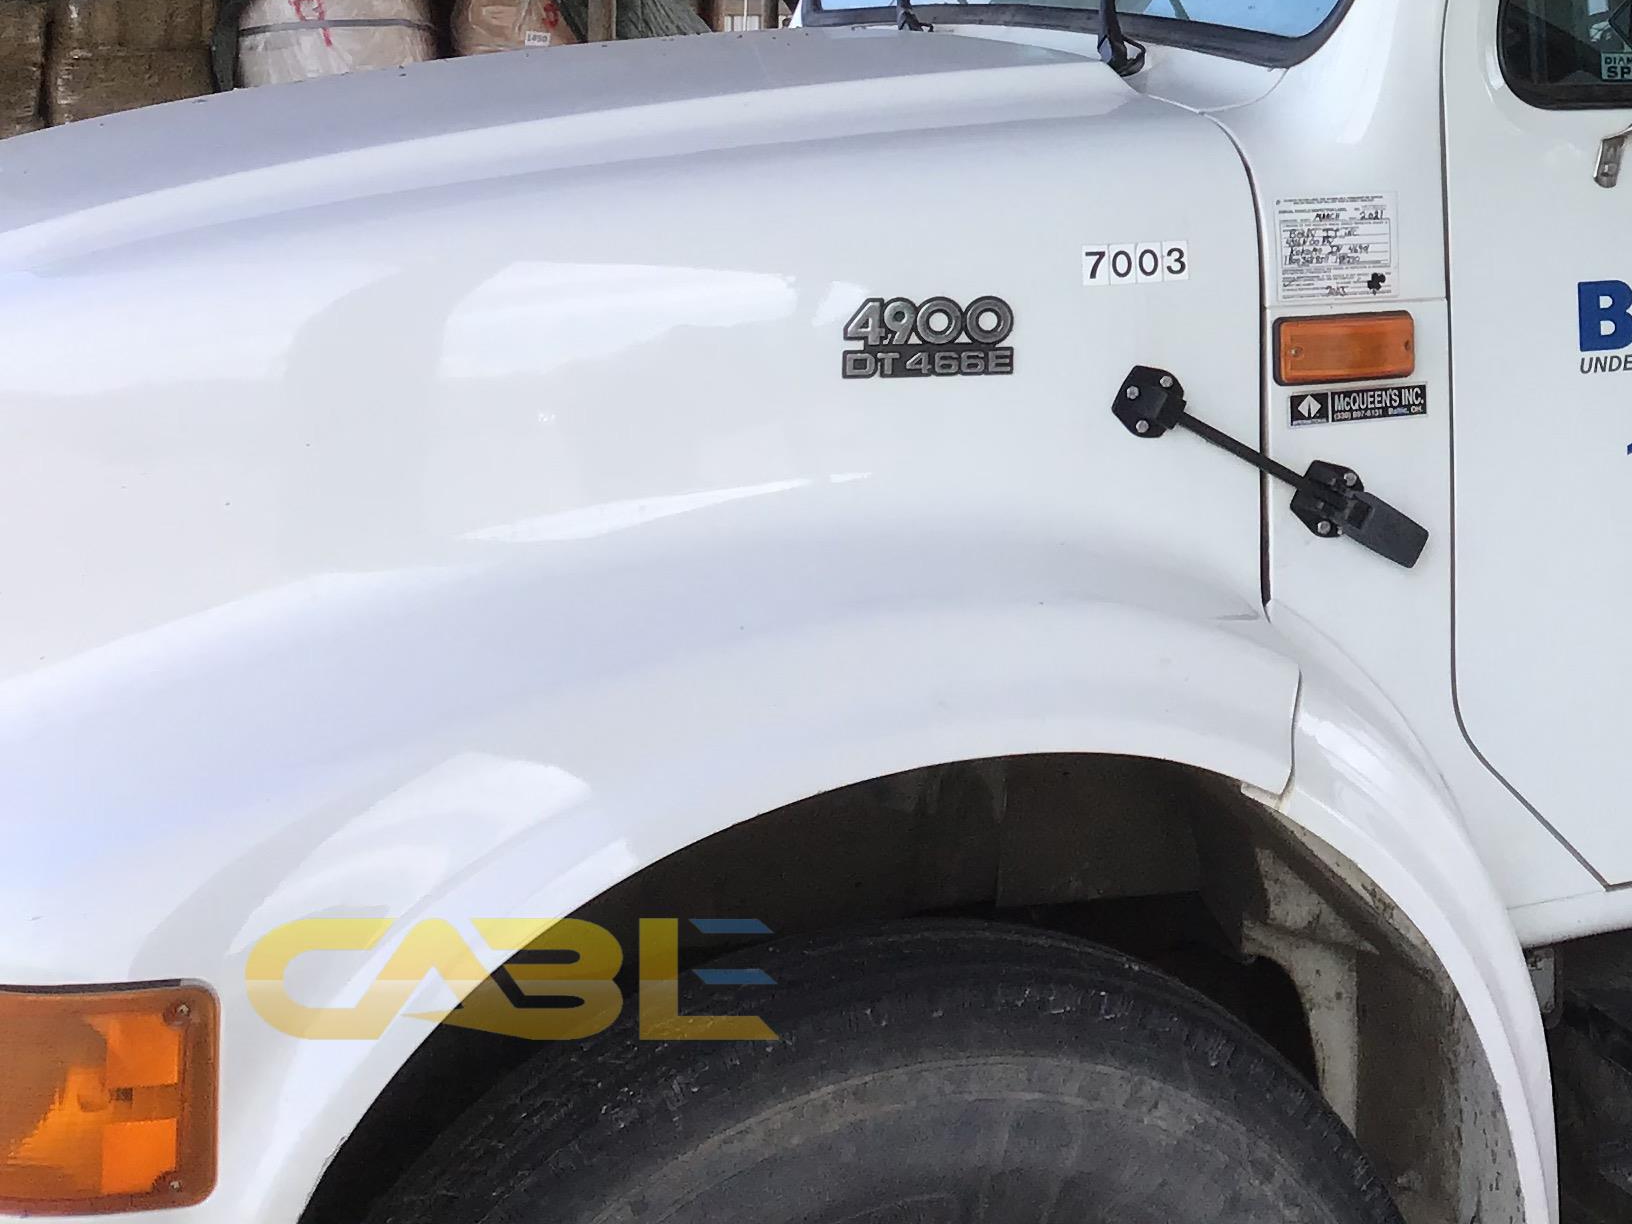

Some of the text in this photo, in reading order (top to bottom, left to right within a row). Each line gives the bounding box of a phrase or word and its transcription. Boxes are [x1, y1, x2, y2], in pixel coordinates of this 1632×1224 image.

[1085, 247, 1187, 280] 7003
[843, 296, 1014, 346] 4900
[1334, 387, 1425, 412] McQUEEN'S INC.
